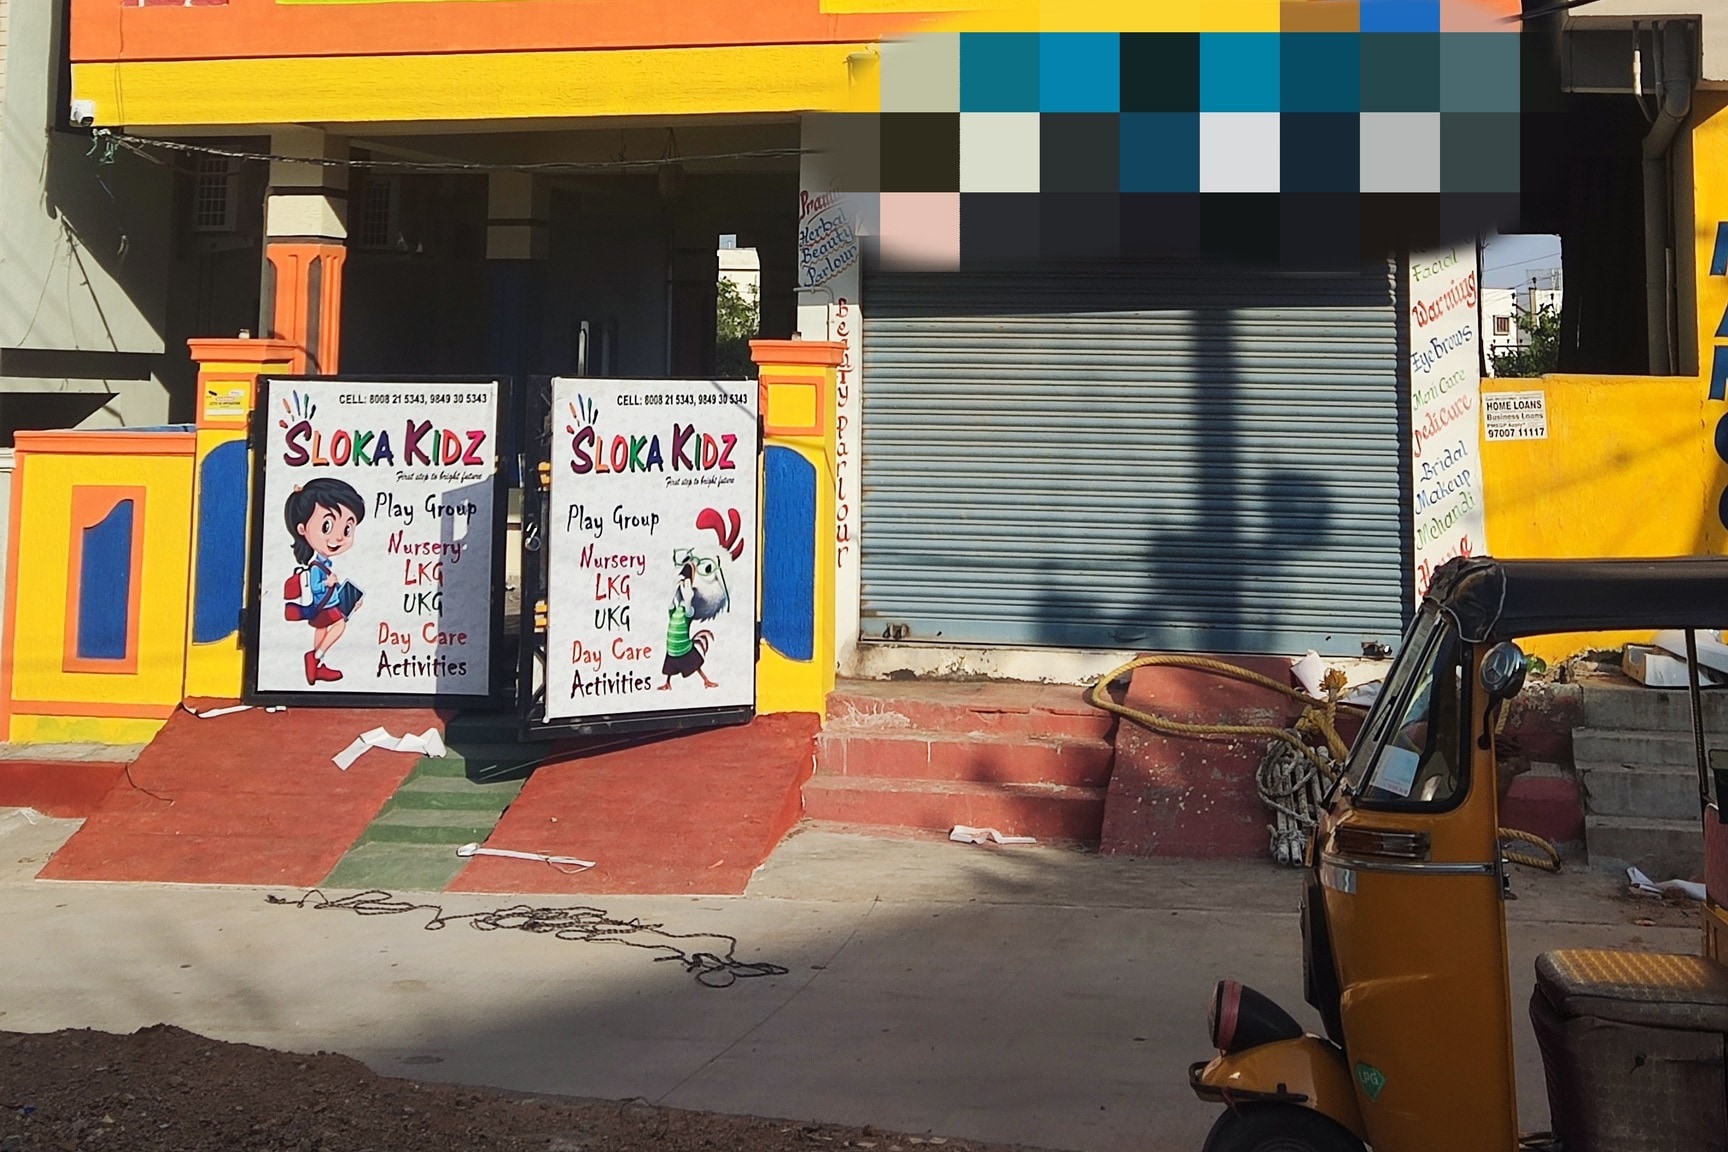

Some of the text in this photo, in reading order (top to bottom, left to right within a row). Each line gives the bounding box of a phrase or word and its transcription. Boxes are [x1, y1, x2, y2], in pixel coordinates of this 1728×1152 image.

[799, 207, 847, 247] Herbal
[800, 225, 854, 266] Beauty
[804, 245, 857, 287] Parlour
[1412, 247, 1459, 282] Facial
[339, 393, 487, 405] CELL: 8008 21 5343, 9849 30 5343
[617, 394, 747, 406] CELL: 8008 21 5343, 9849 30 5343
[1486, 400, 1542, 411] HOME LOANS
[283, 419, 487, 467] SLOKA KIDZ
[570, 423, 738, 474] SLOKA KIDZ
[1488, 428, 1544, 438] 97007 11117
[1420, 440, 1468, 482] Bridal
[374, 492, 477, 527] Play Group
[567, 504, 659, 538] Play Group
[388, 530, 462, 563] Nursery
[580, 543, 646, 575] Nursery
[404, 559, 443, 587] LKG
[595, 573, 631, 601] LKG
[403, 592, 443, 616] UKG
[594, 606, 631, 632] UKG
[378, 622, 468, 654] Day Care
[376, 650, 467, 678] Activities
[571, 638, 652, 672] Day Care
[570, 670, 651, 699] Activities
